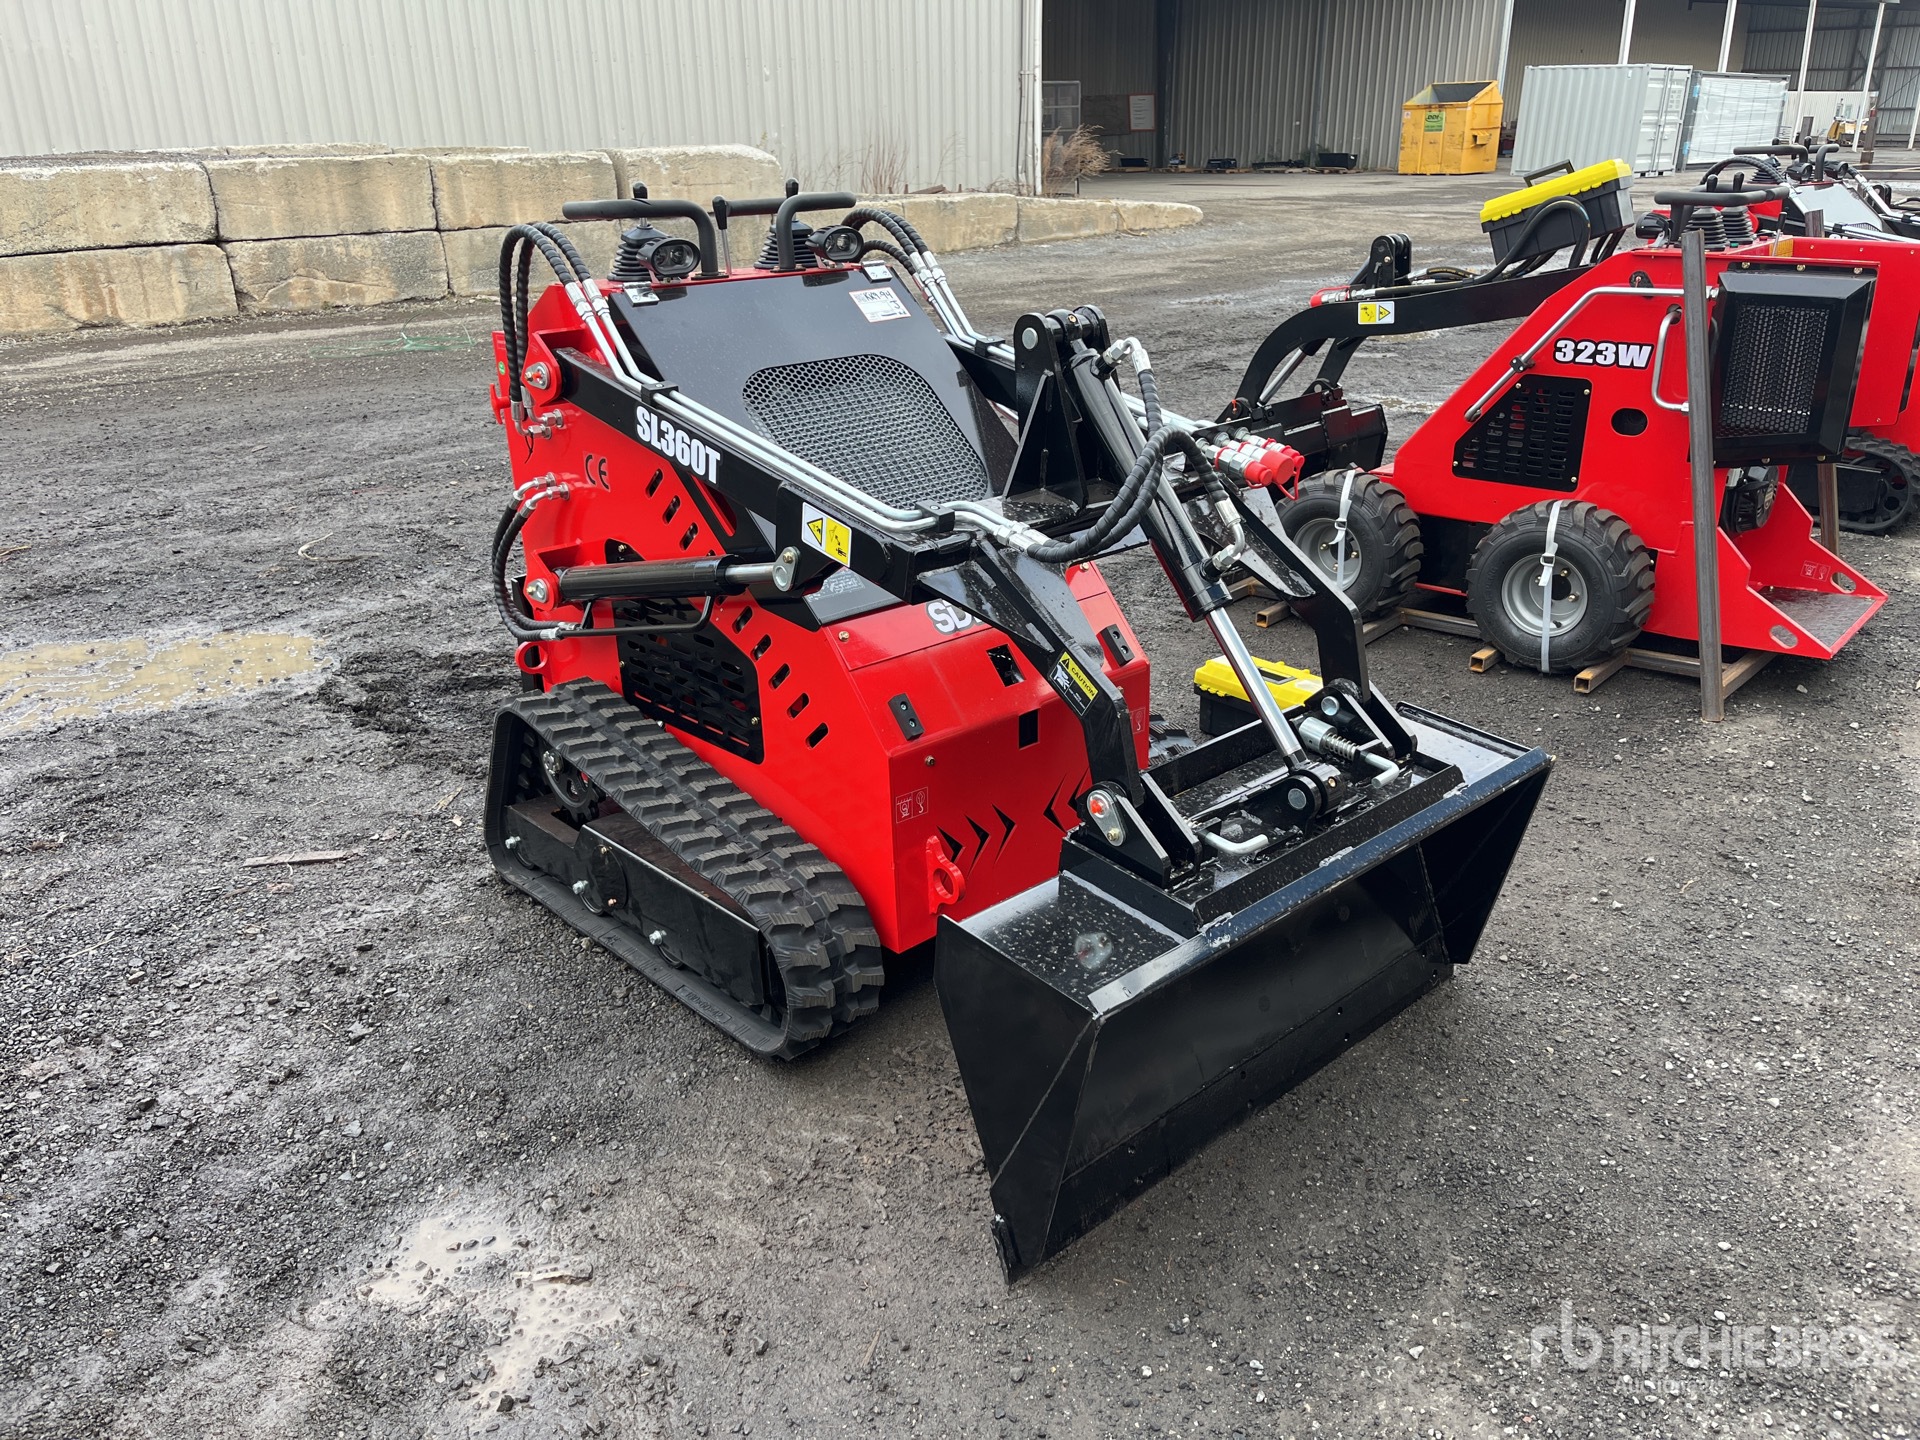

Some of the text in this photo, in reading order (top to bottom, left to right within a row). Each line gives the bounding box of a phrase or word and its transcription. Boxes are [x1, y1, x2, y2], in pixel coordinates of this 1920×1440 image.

[1555, 339, 1652, 368] 323W
[636, 405, 721, 484] SL360T
[585, 454, 611, 490] CE
[1071, 667, 1096, 697] CAUTION
